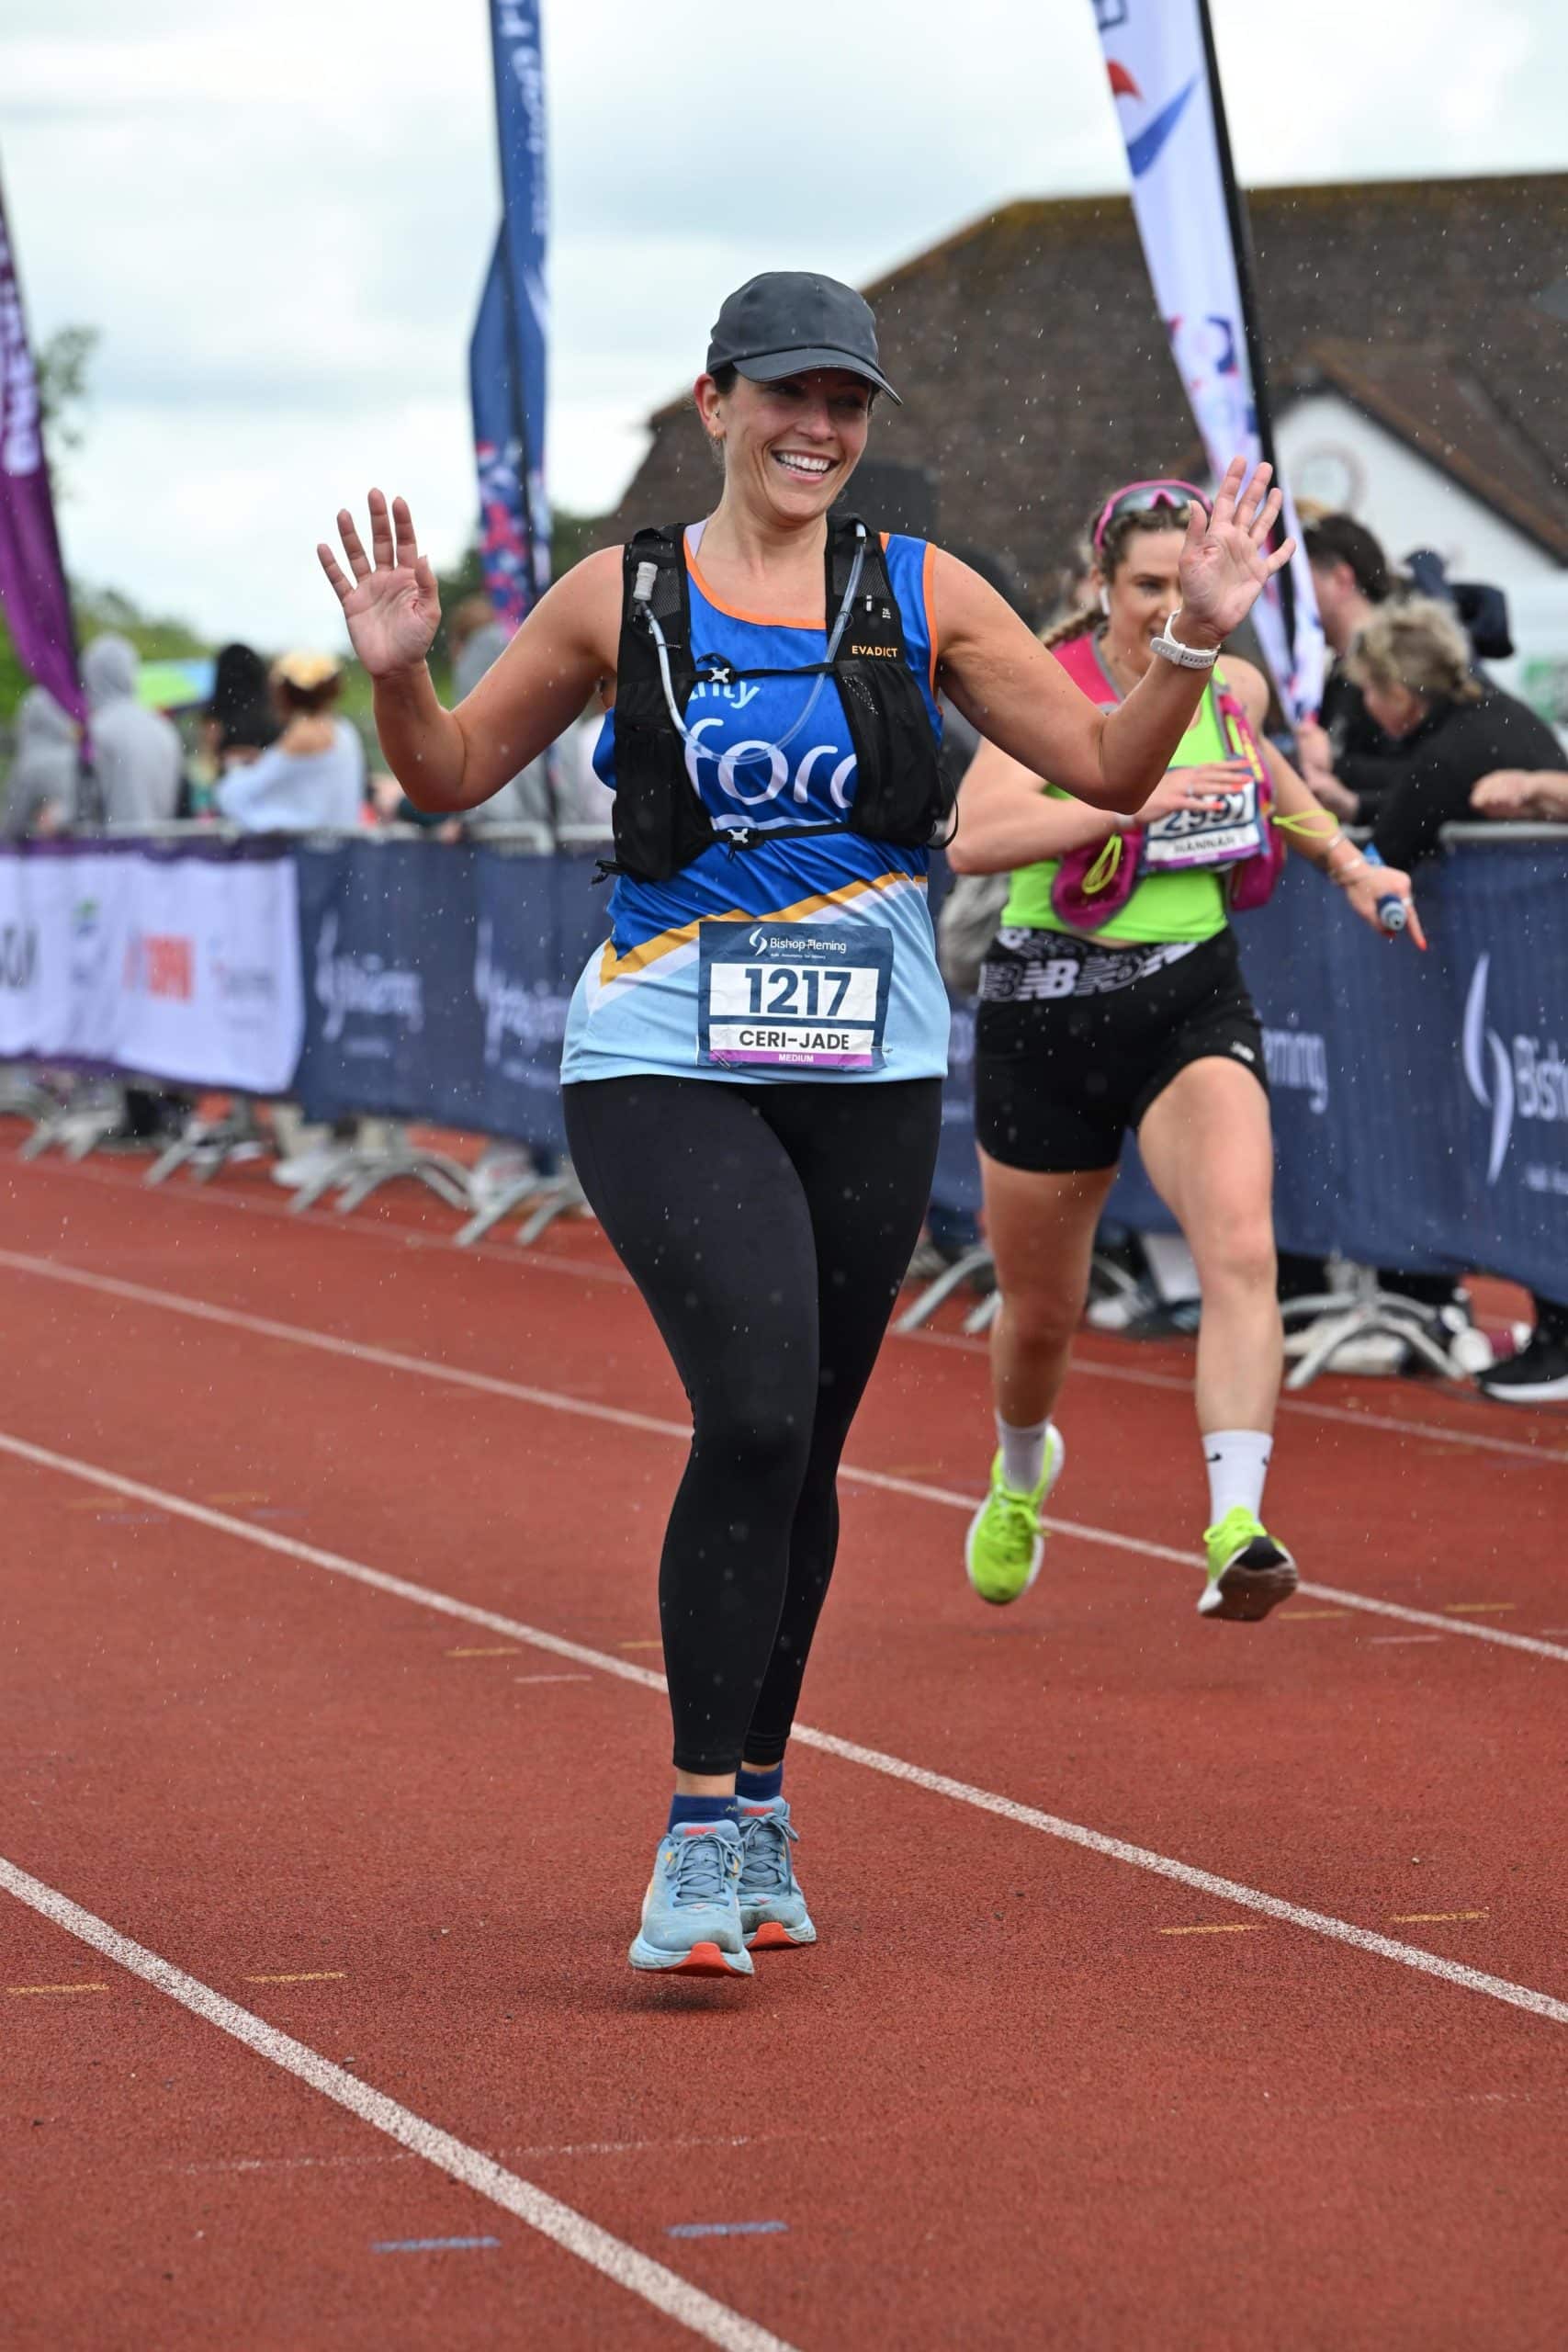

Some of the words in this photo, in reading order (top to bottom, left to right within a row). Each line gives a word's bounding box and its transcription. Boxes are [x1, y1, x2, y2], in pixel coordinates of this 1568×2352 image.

[852, 645, 897, 658] EVADICT
[770, 937, 805, 951] Bishop
[807, 939, 847, 954] Fleming
[745, 967, 852, 1016] 1217
[739, 1030, 850, 1050] CERI-JADE
[778, 1053, 814, 1063] MEDIUM
